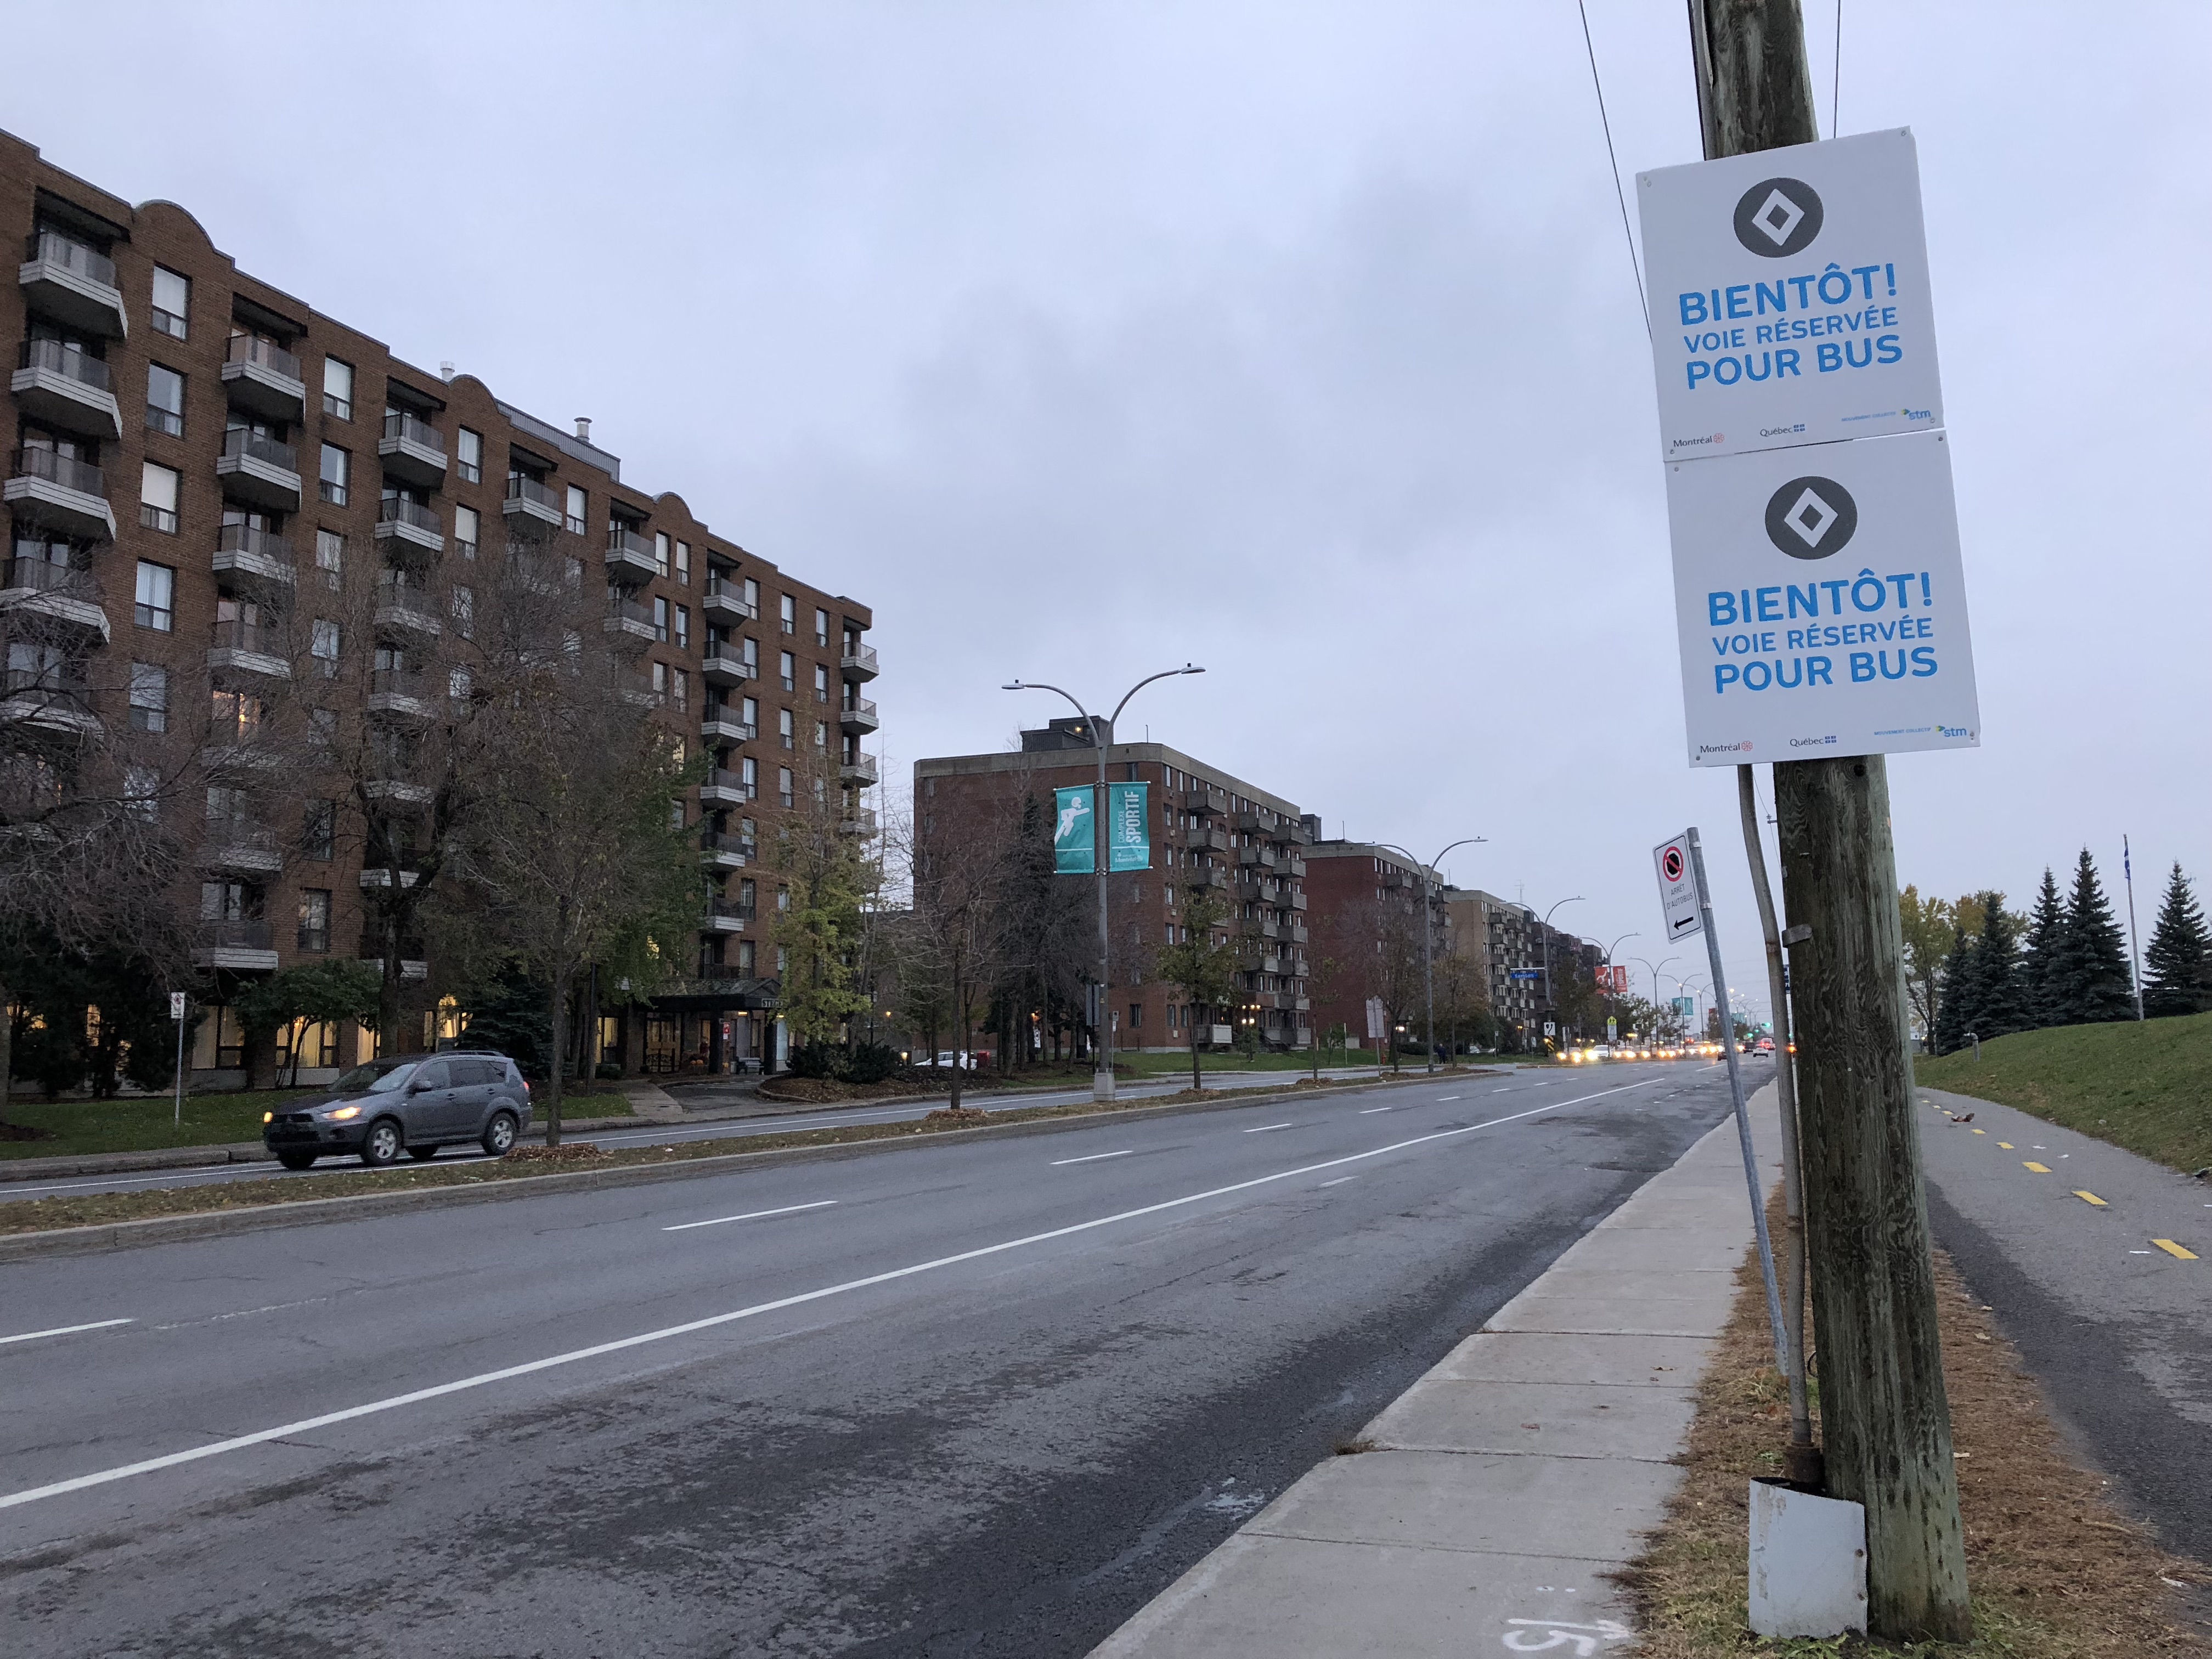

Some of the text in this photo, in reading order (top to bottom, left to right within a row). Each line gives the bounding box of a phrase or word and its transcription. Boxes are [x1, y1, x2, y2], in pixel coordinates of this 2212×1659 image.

[1679, 263, 1897, 326] BIENTÔT!
[1684, 306, 1898, 353] VOIE RÉSERVÉE
[1686, 335, 1903, 390] POUR BUS
[1908, 410, 1931, 420] stm
[1759, 426, 1792, 437] Québec
[1673, 436, 1712, 447] Montréal
[1708, 568, 1933, 627] BIENTÔT!
[1712, 614, 1934, 656] VOIE RÉSERVÉE
[1715, 647, 1938, 694] POUR BUS
[1944, 727, 1967, 737] stm
[1700, 743, 1740, 753] Montréal
[1790, 735, 1824, 747] Québec
[1125, 791, 1142, 843] SPORTIF
[1671, 883, 1685, 896] ARRÊT
[1667, 893, 1693, 910] D'AUTOBUS
